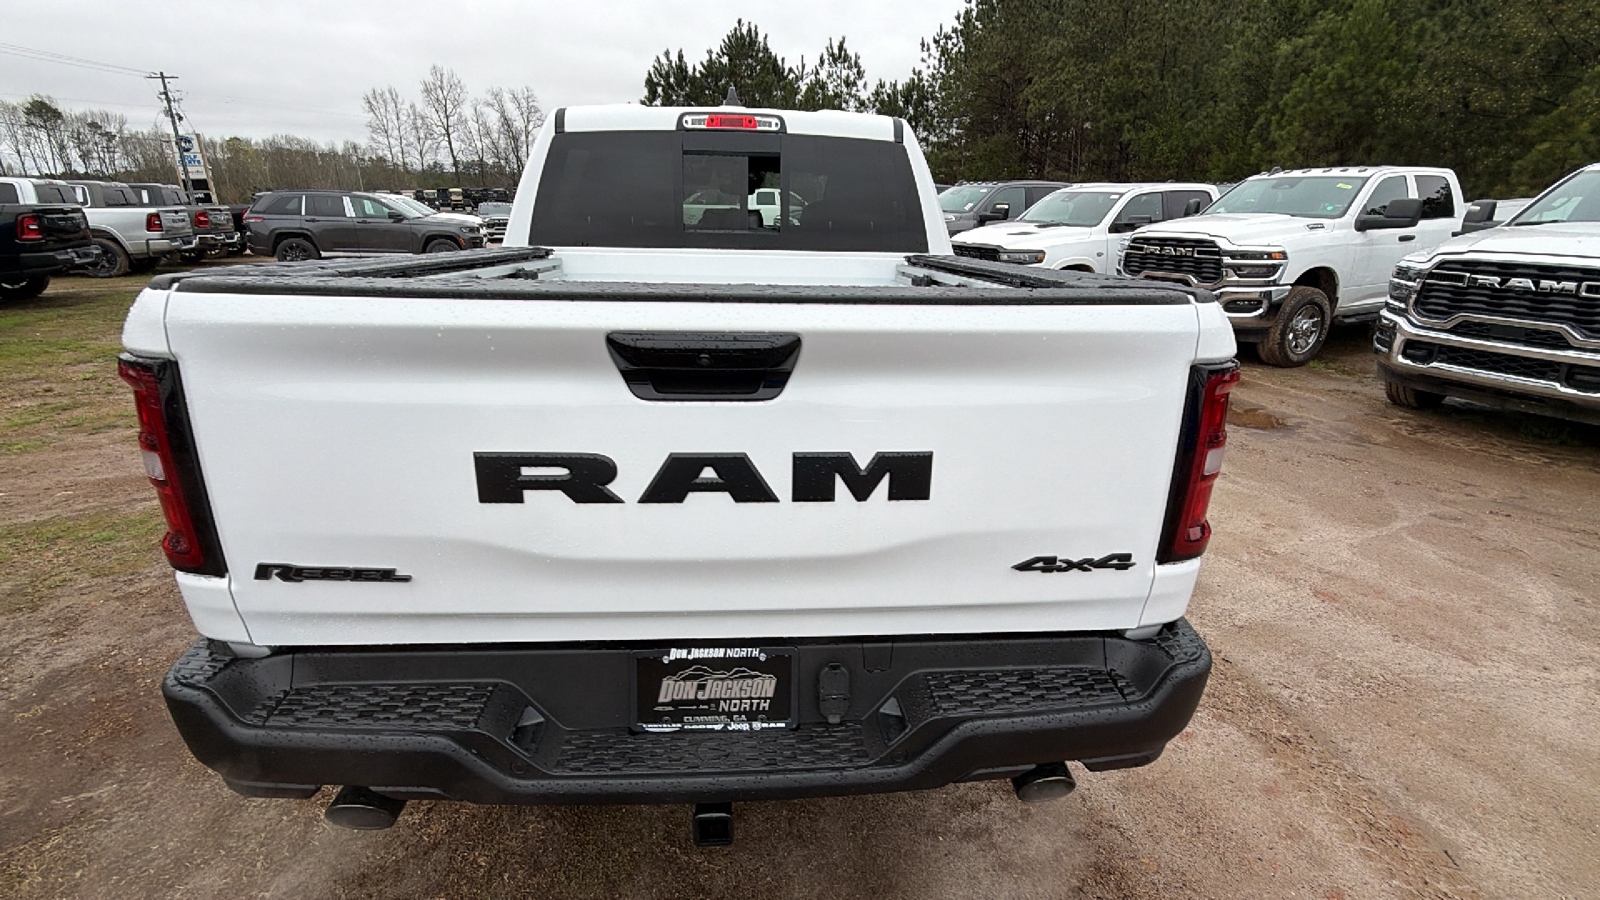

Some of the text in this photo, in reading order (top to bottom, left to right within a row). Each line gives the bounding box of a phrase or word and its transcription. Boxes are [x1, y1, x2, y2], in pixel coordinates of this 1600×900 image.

[1145, 246, 1193, 256] RAM
[1469, 274, 1578, 294] RAM
[474, 450, 933, 504] RAM
[1010, 553, 1137, 573] 4x4
[253, 562, 413, 583] REBEL
[670, 648, 760, 660] DON JACKSON NORTH
[658, 679, 777, 703] DON JACKSON
[718, 700, 771, 712] NORTH
[727, 721, 751, 731] Jeep
[733, 714, 748, 722] GA
